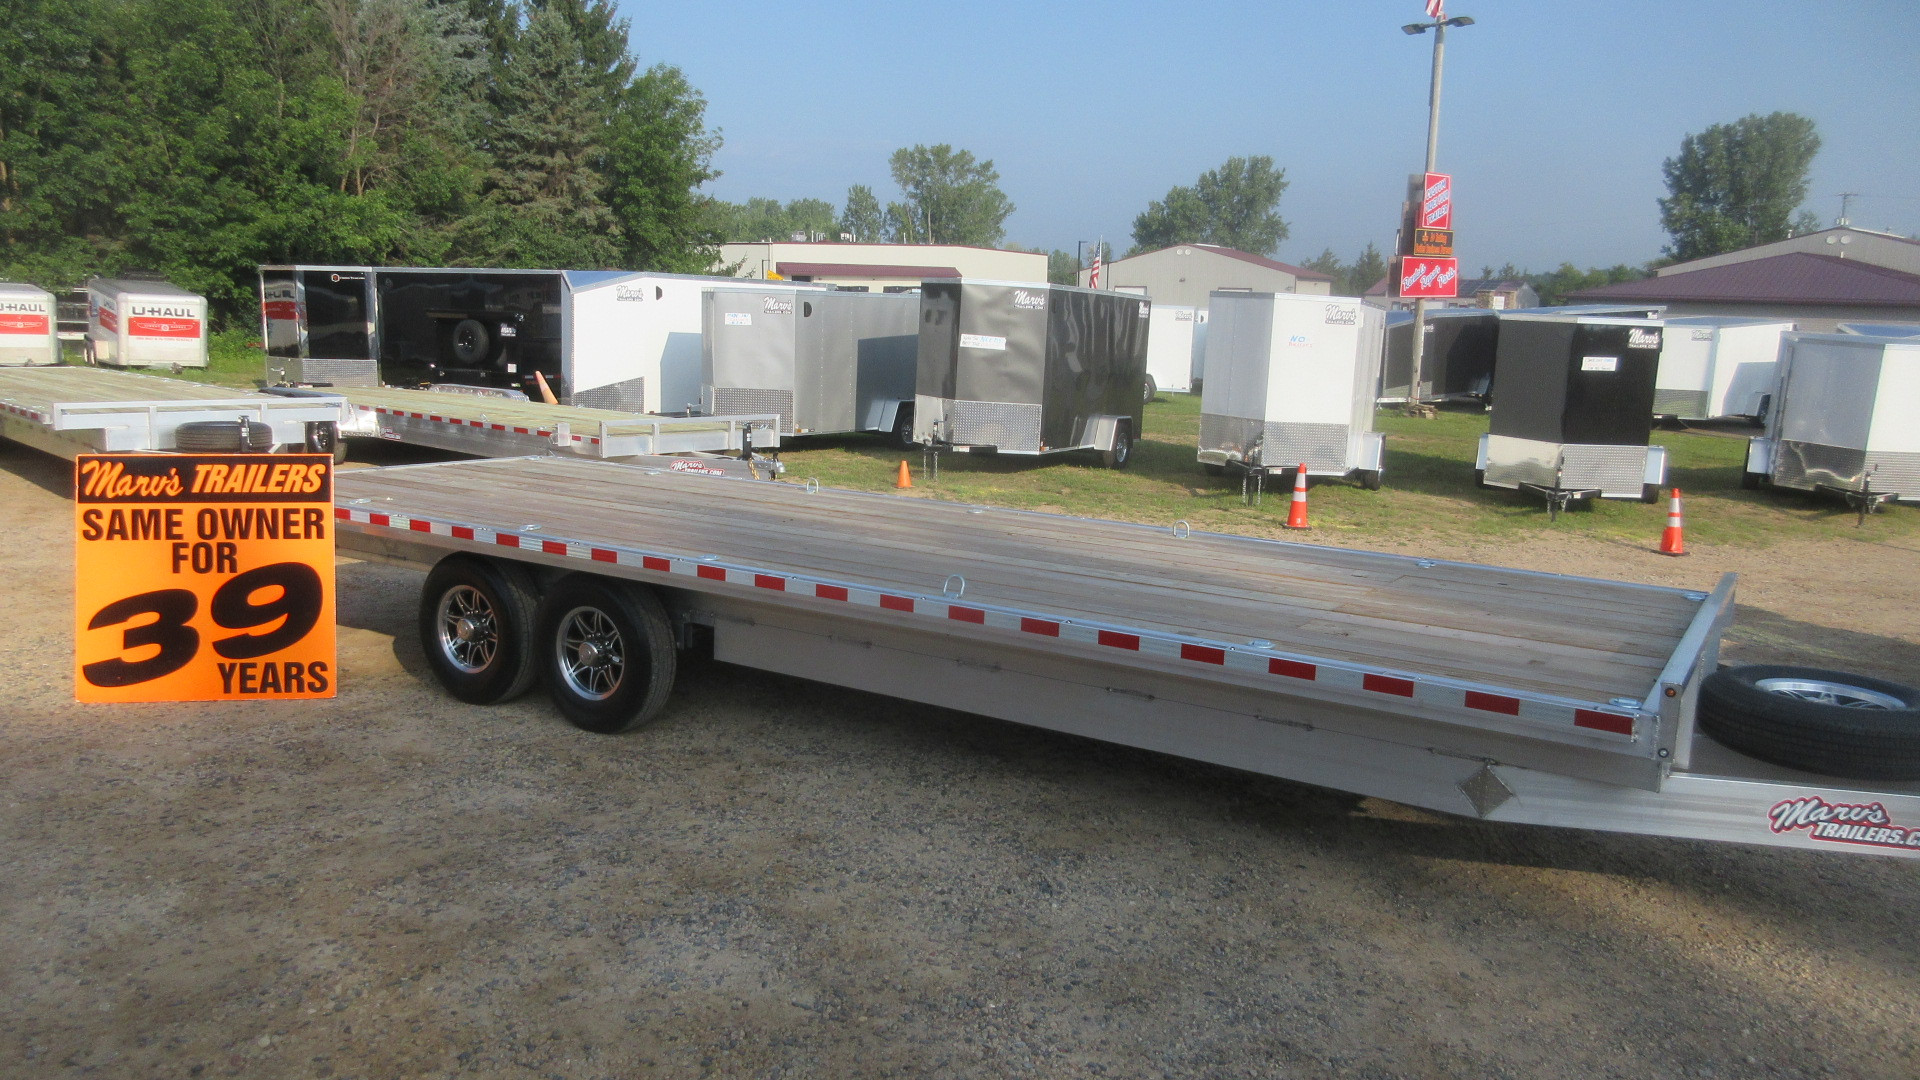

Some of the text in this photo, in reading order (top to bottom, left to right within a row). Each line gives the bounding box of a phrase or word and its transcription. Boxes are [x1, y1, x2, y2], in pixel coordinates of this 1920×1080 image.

[763, 296, 793, 311] Marv's
[1014, 289, 1046, 305] Marv's
[132, 306, 195, 317] U-HAUL
[1325, 304, 1356, 321] Marv's
[1628, 328, 1659, 344] Marv's
[671, 460, 703, 471] Marv's
[81, 459, 326, 499] Marv's TRAILERS
[82, 508, 325, 541] SAME OWNER
[172, 541, 238, 574] FOR
[82, 561, 324, 688] 39
[217, 661, 329, 694] YEARS
[1771, 798, 1888, 830] Marv's
